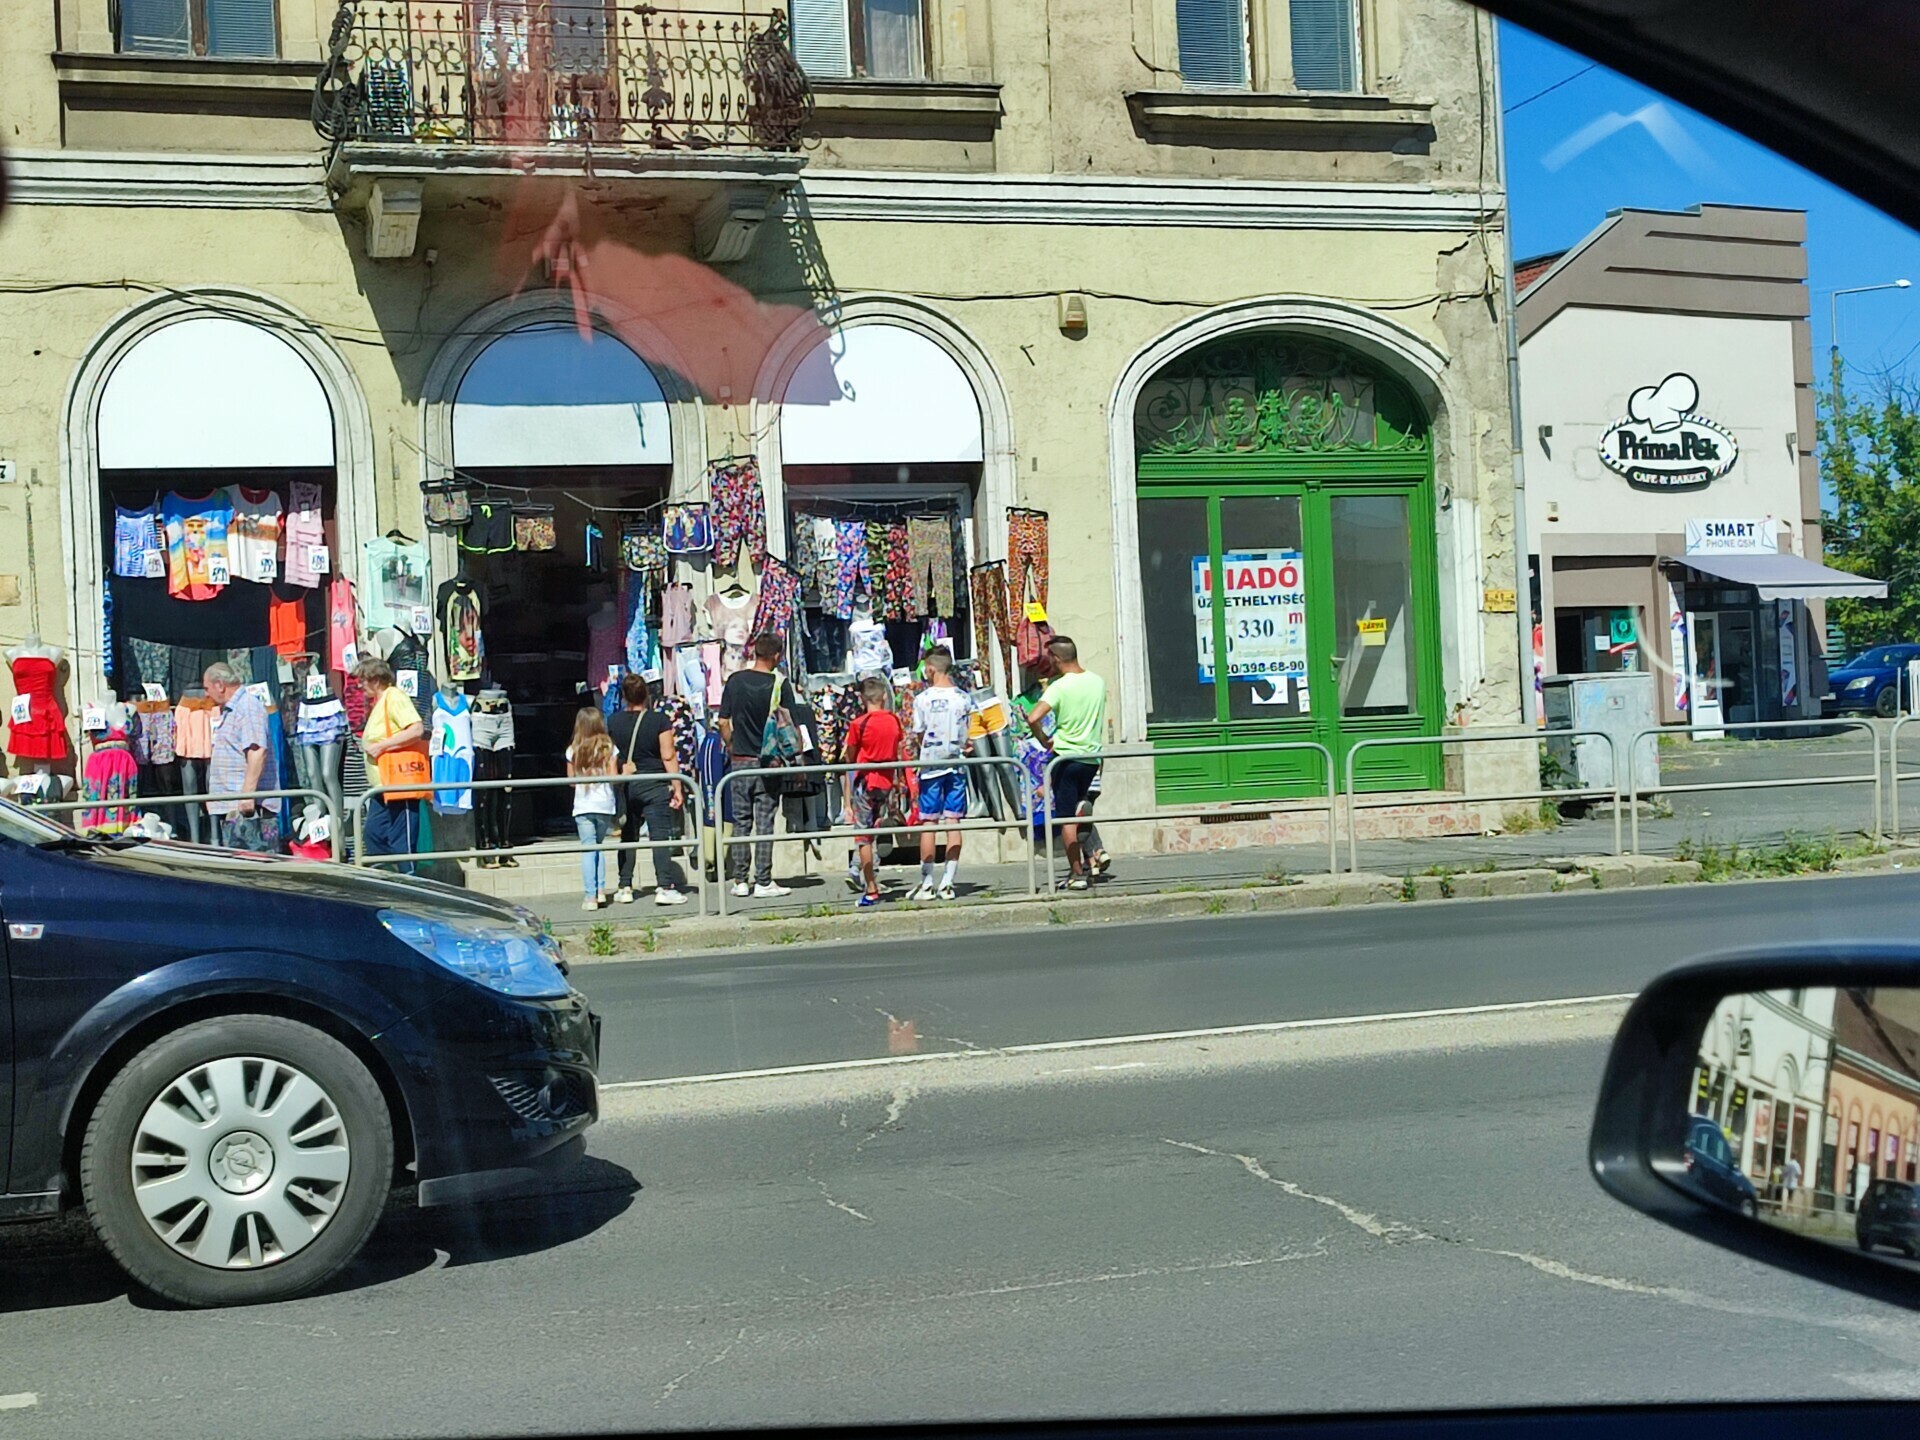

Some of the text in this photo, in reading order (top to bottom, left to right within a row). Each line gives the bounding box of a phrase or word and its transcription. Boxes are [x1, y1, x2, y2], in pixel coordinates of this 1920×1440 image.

[1705, 523, 1755, 537] SMART
[1706, 538, 1756, 548] PHONE GSM
[1238, 619, 1274, 639] 330
[1201, 635, 1234, 654] 10
